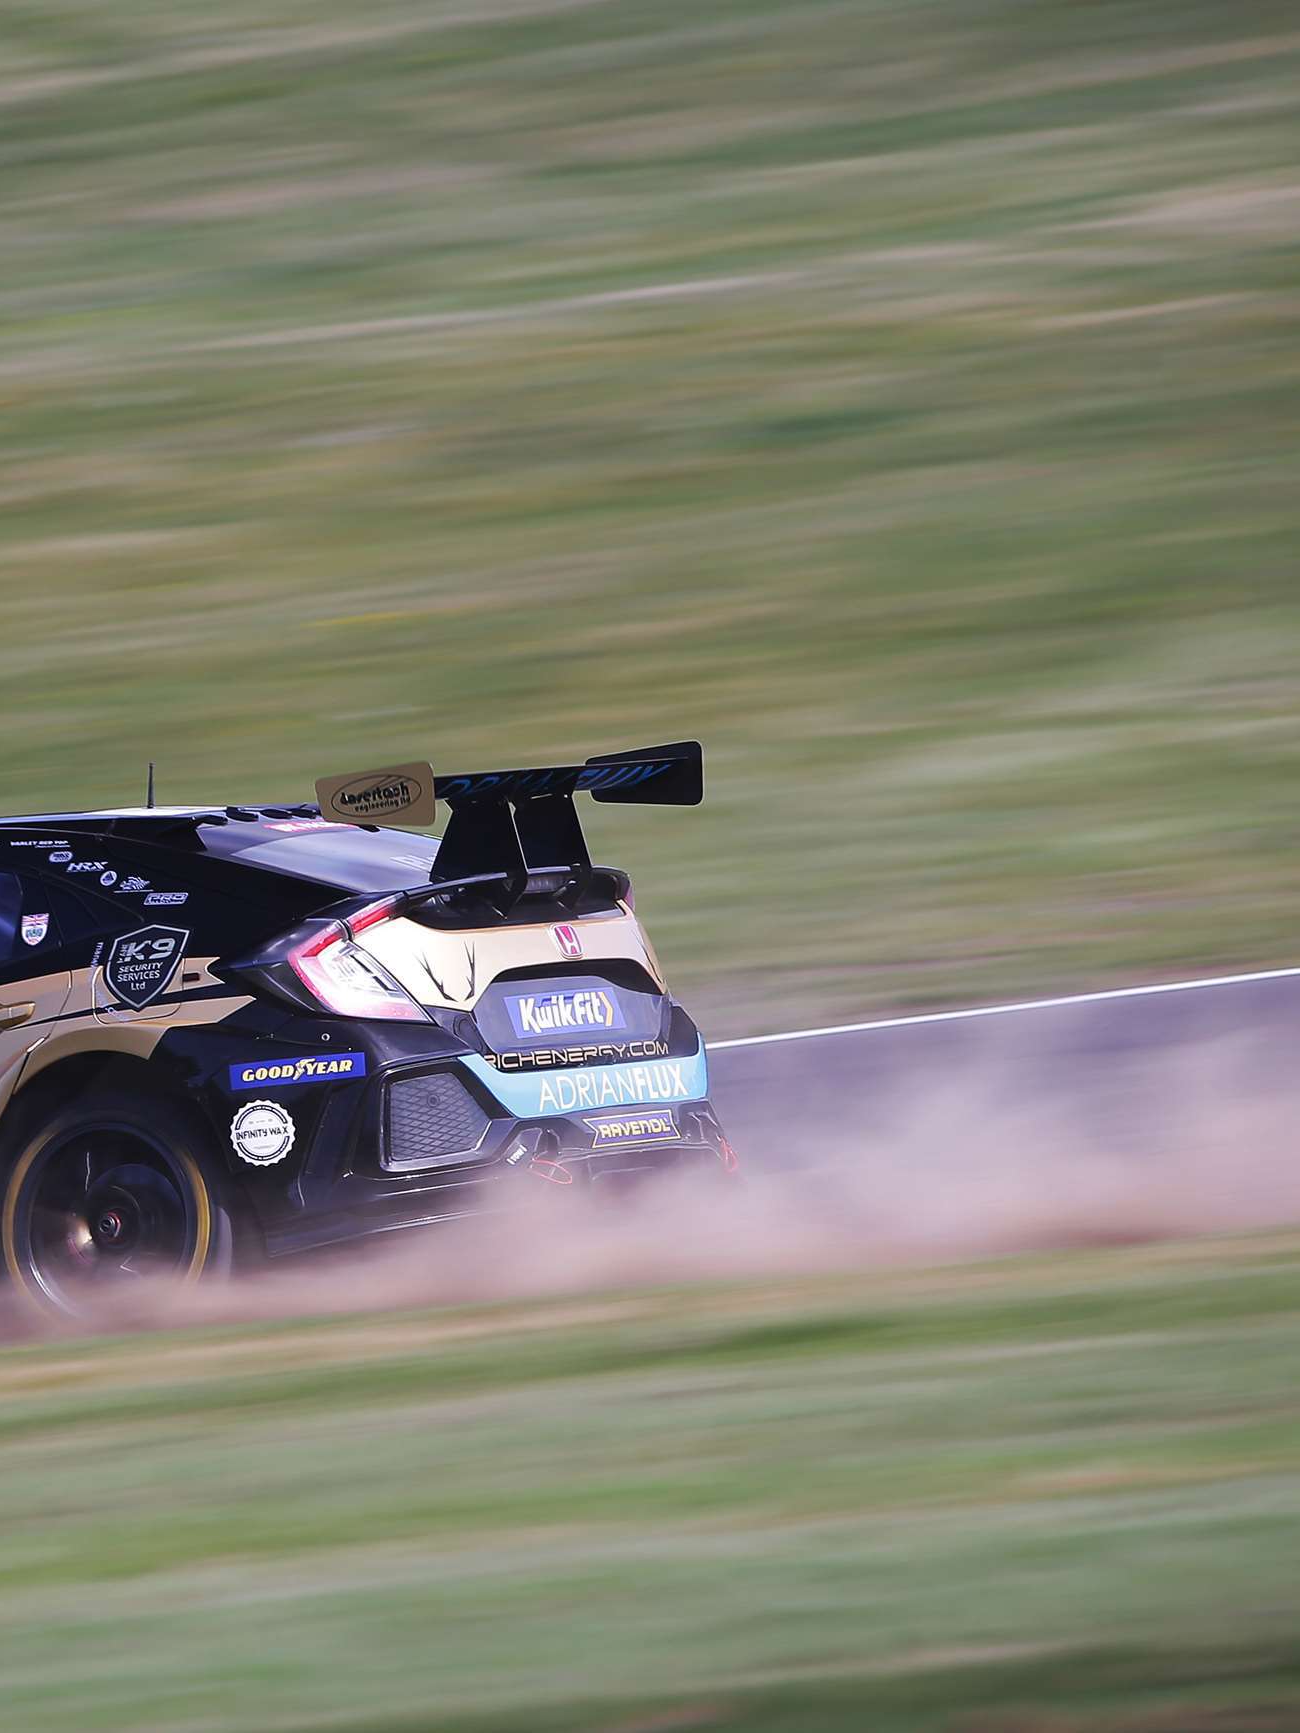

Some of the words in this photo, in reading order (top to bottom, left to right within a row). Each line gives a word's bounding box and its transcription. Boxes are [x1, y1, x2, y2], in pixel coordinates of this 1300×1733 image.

[118, 961, 164, 974] SECURITY
[117, 970, 161, 983] SERVICES
[131, 981, 147, 991] Ltd
[242, 1058, 353, 1082] GOODYEAR
[539, 1064, 688, 1112] ADRIANFLUX
[236, 1128, 268, 1141] INFINITY
[600, 1118, 670, 1139] RAVENOL
